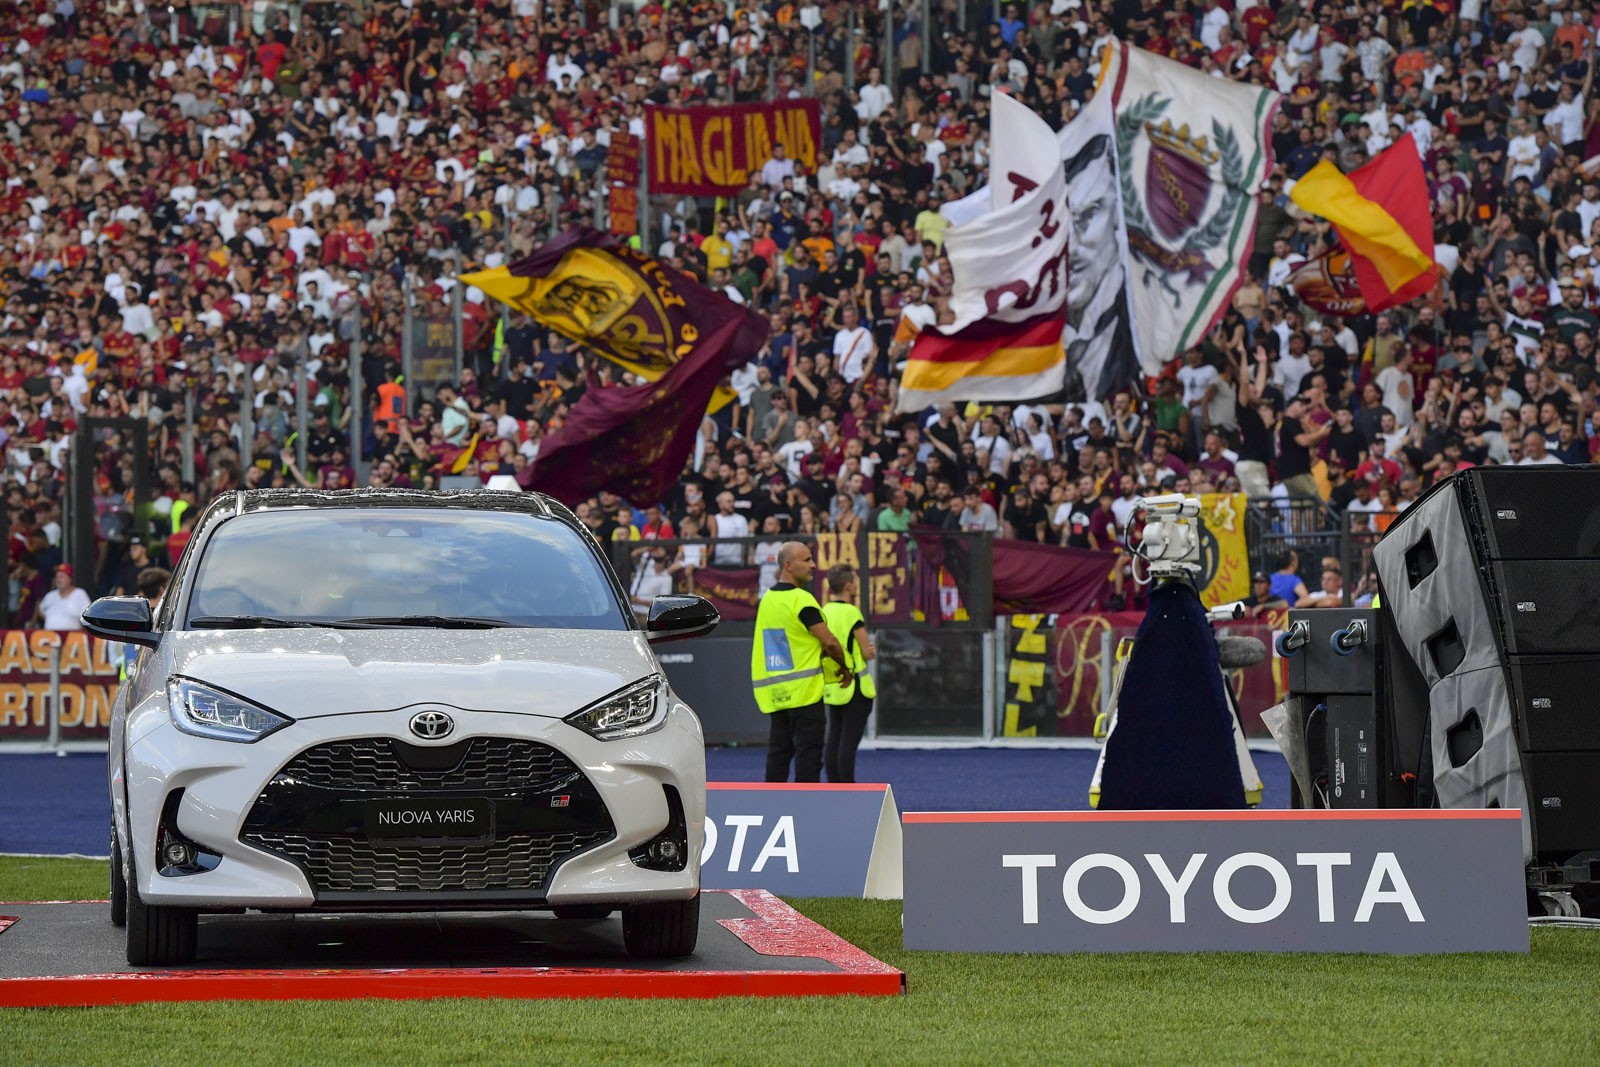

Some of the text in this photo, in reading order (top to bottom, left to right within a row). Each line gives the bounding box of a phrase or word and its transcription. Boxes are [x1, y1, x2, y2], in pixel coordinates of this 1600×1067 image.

[653, 108, 818, 187] MAGLIANA
[379, 809, 475, 825] NUOVA YARIS
[1002, 851, 1425, 925] TOYOTA
